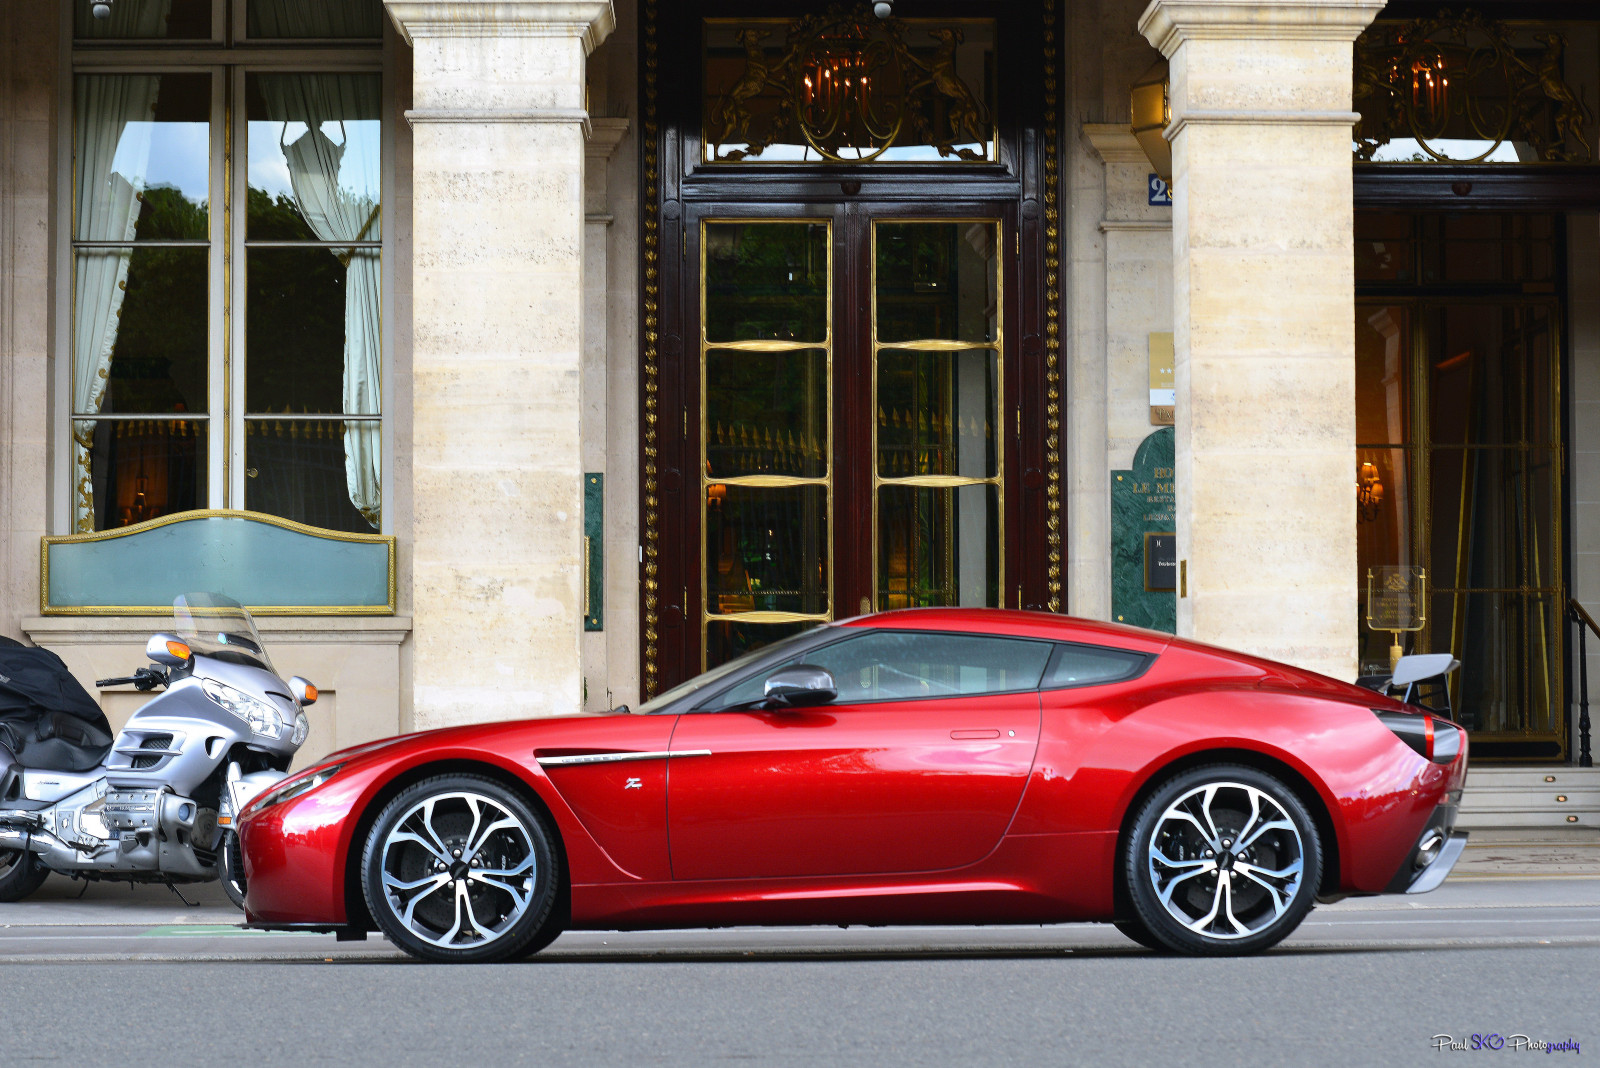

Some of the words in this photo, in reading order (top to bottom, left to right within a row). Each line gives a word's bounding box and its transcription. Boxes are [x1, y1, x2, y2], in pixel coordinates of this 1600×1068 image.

[1151, 178, 1172, 201] 2
[1154, 467, 1175, 478] HO
[1133, 483, 1150, 493] LE
